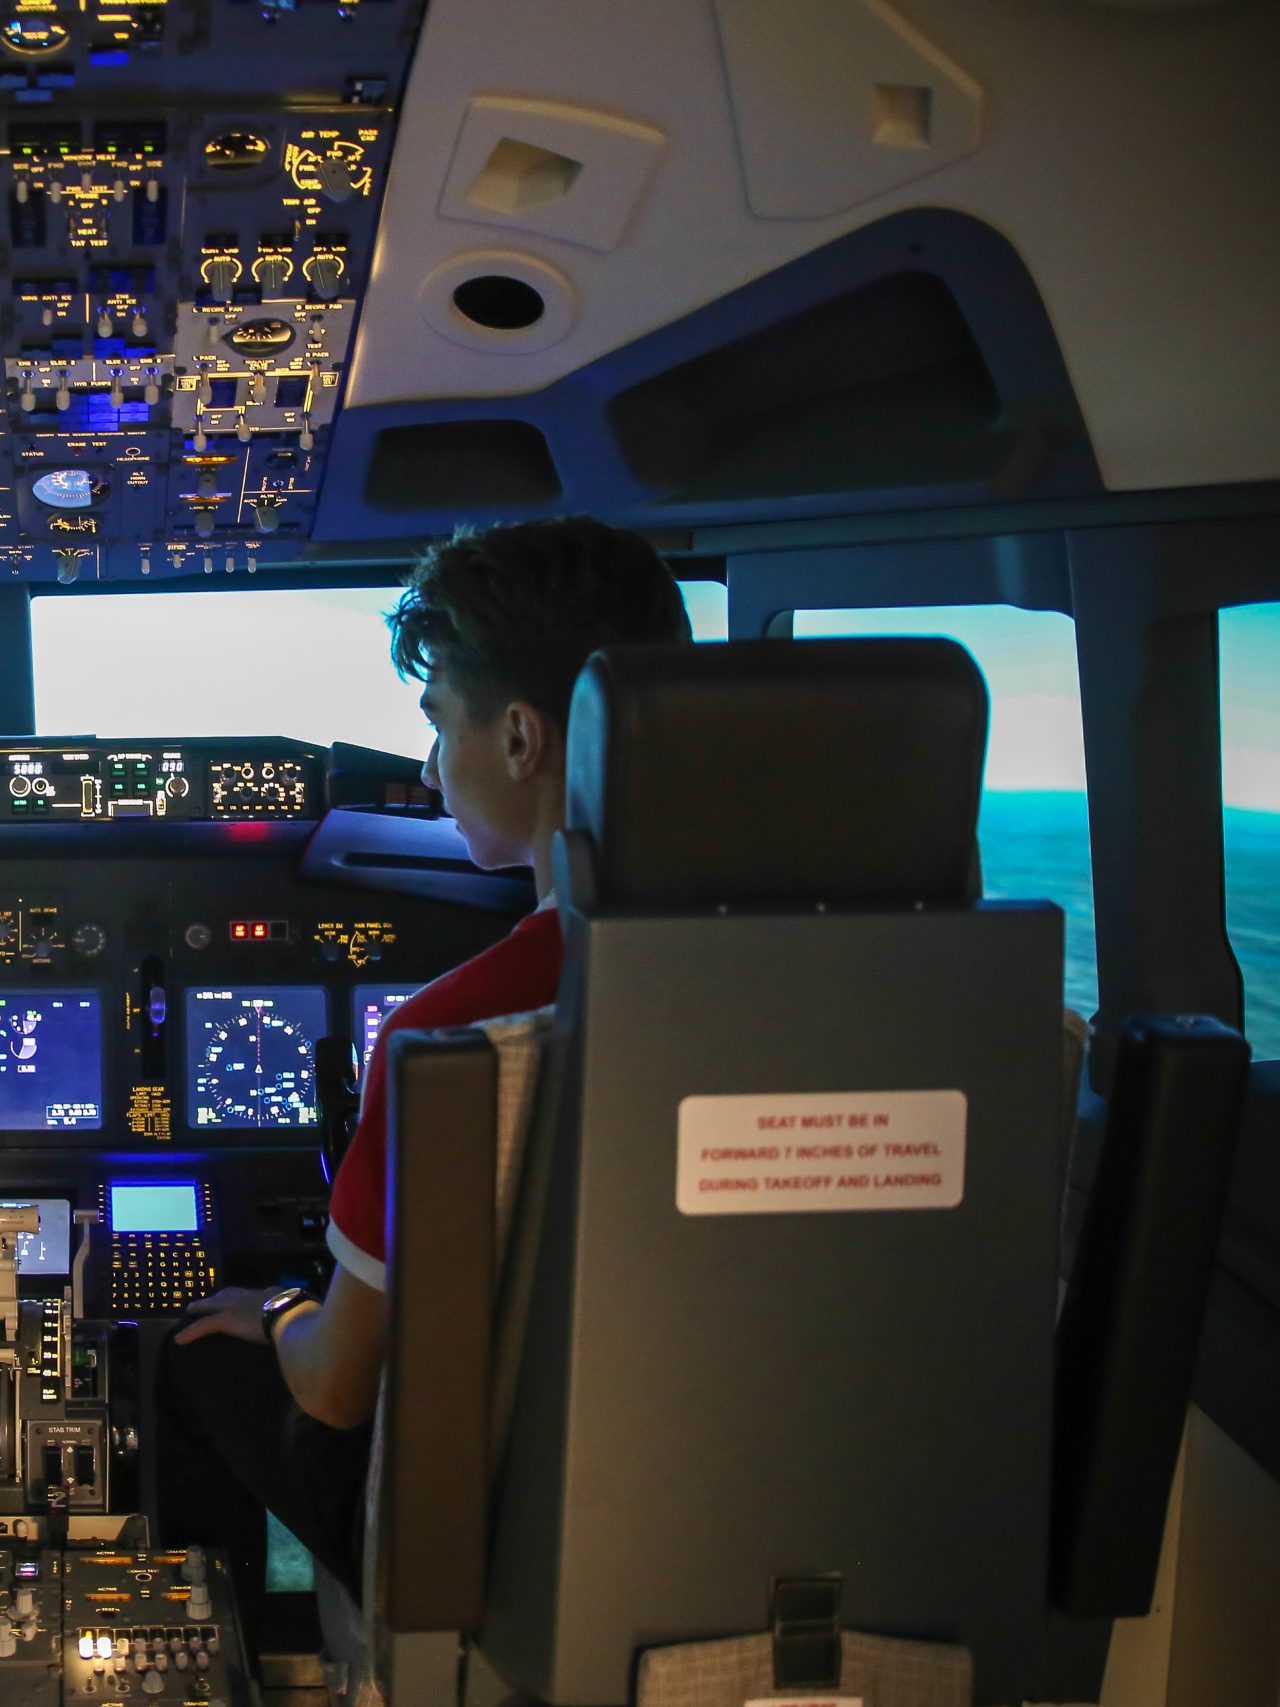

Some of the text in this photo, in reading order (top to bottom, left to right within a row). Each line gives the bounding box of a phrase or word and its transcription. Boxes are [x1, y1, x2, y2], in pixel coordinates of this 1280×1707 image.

[162, 762, 183, 772] 090
[758, 1114, 888, 1129] SEAT MUST BE IN
[701, 1148, 779, 1161] FORWARD
[796, 1146, 852, 1159] INCHES
[858, 1145, 876, 1158] OF
[883, 1143, 940, 1156] TRAVEL
[699, 1173, 942, 1191] DURING TAKEOFF AND LANDING
[52, 1492, 66, 1507] 2
